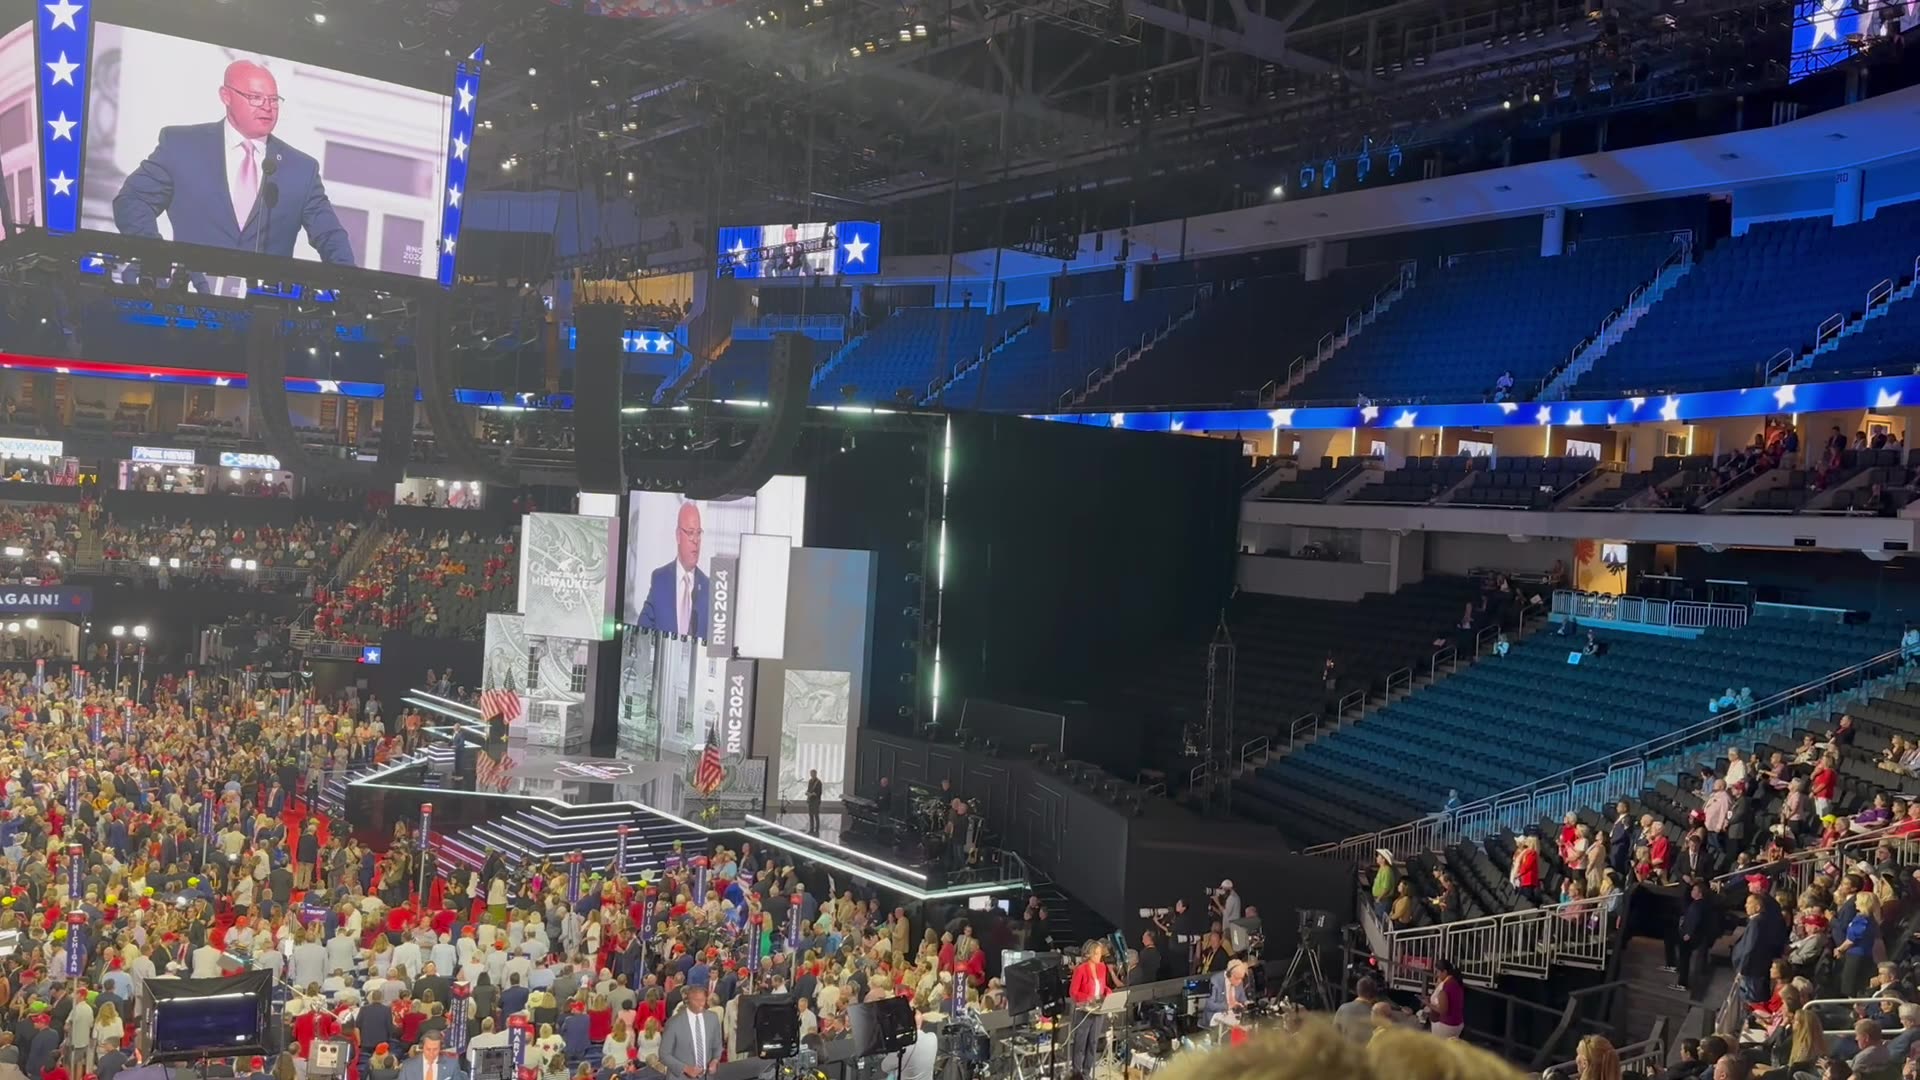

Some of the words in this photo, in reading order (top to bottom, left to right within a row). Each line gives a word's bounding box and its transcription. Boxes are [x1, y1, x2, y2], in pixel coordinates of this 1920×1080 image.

[645, 901, 654, 932] OHIO
[71, 924, 79, 972] MICHIGAN
[512, 1028, 521, 1080] MARYLAN
